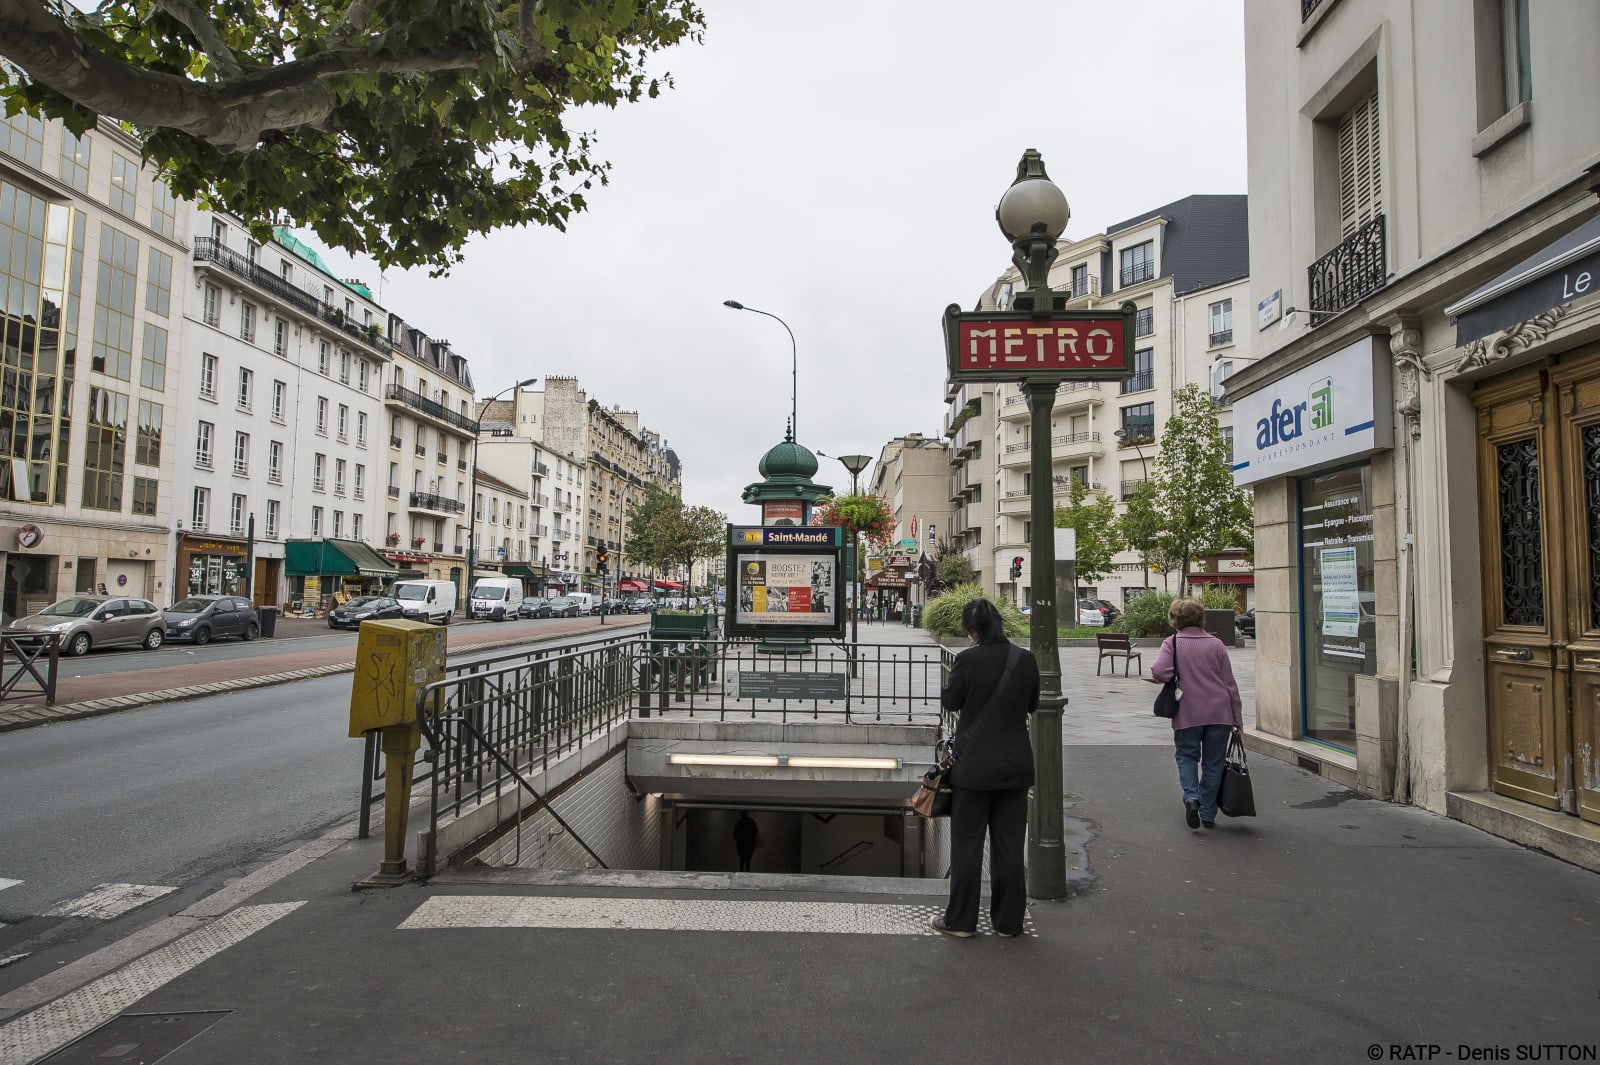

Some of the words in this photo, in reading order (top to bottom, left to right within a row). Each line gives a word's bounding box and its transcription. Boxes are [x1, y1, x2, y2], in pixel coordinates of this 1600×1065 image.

[1563, 272, 1591, 299] Le
[970, 327, 1114, 362] METRO
[1256, 398, 1307, 451] afer
[1257, 432, 1336, 464] CORRESPONDANT
[1324, 498, 1349, 509] Assurance
[1350, 495, 1359, 504] vie
[768, 532, 828, 542] Saint-Mandé
[771, 563, 807, 572] BOOSTEZ
